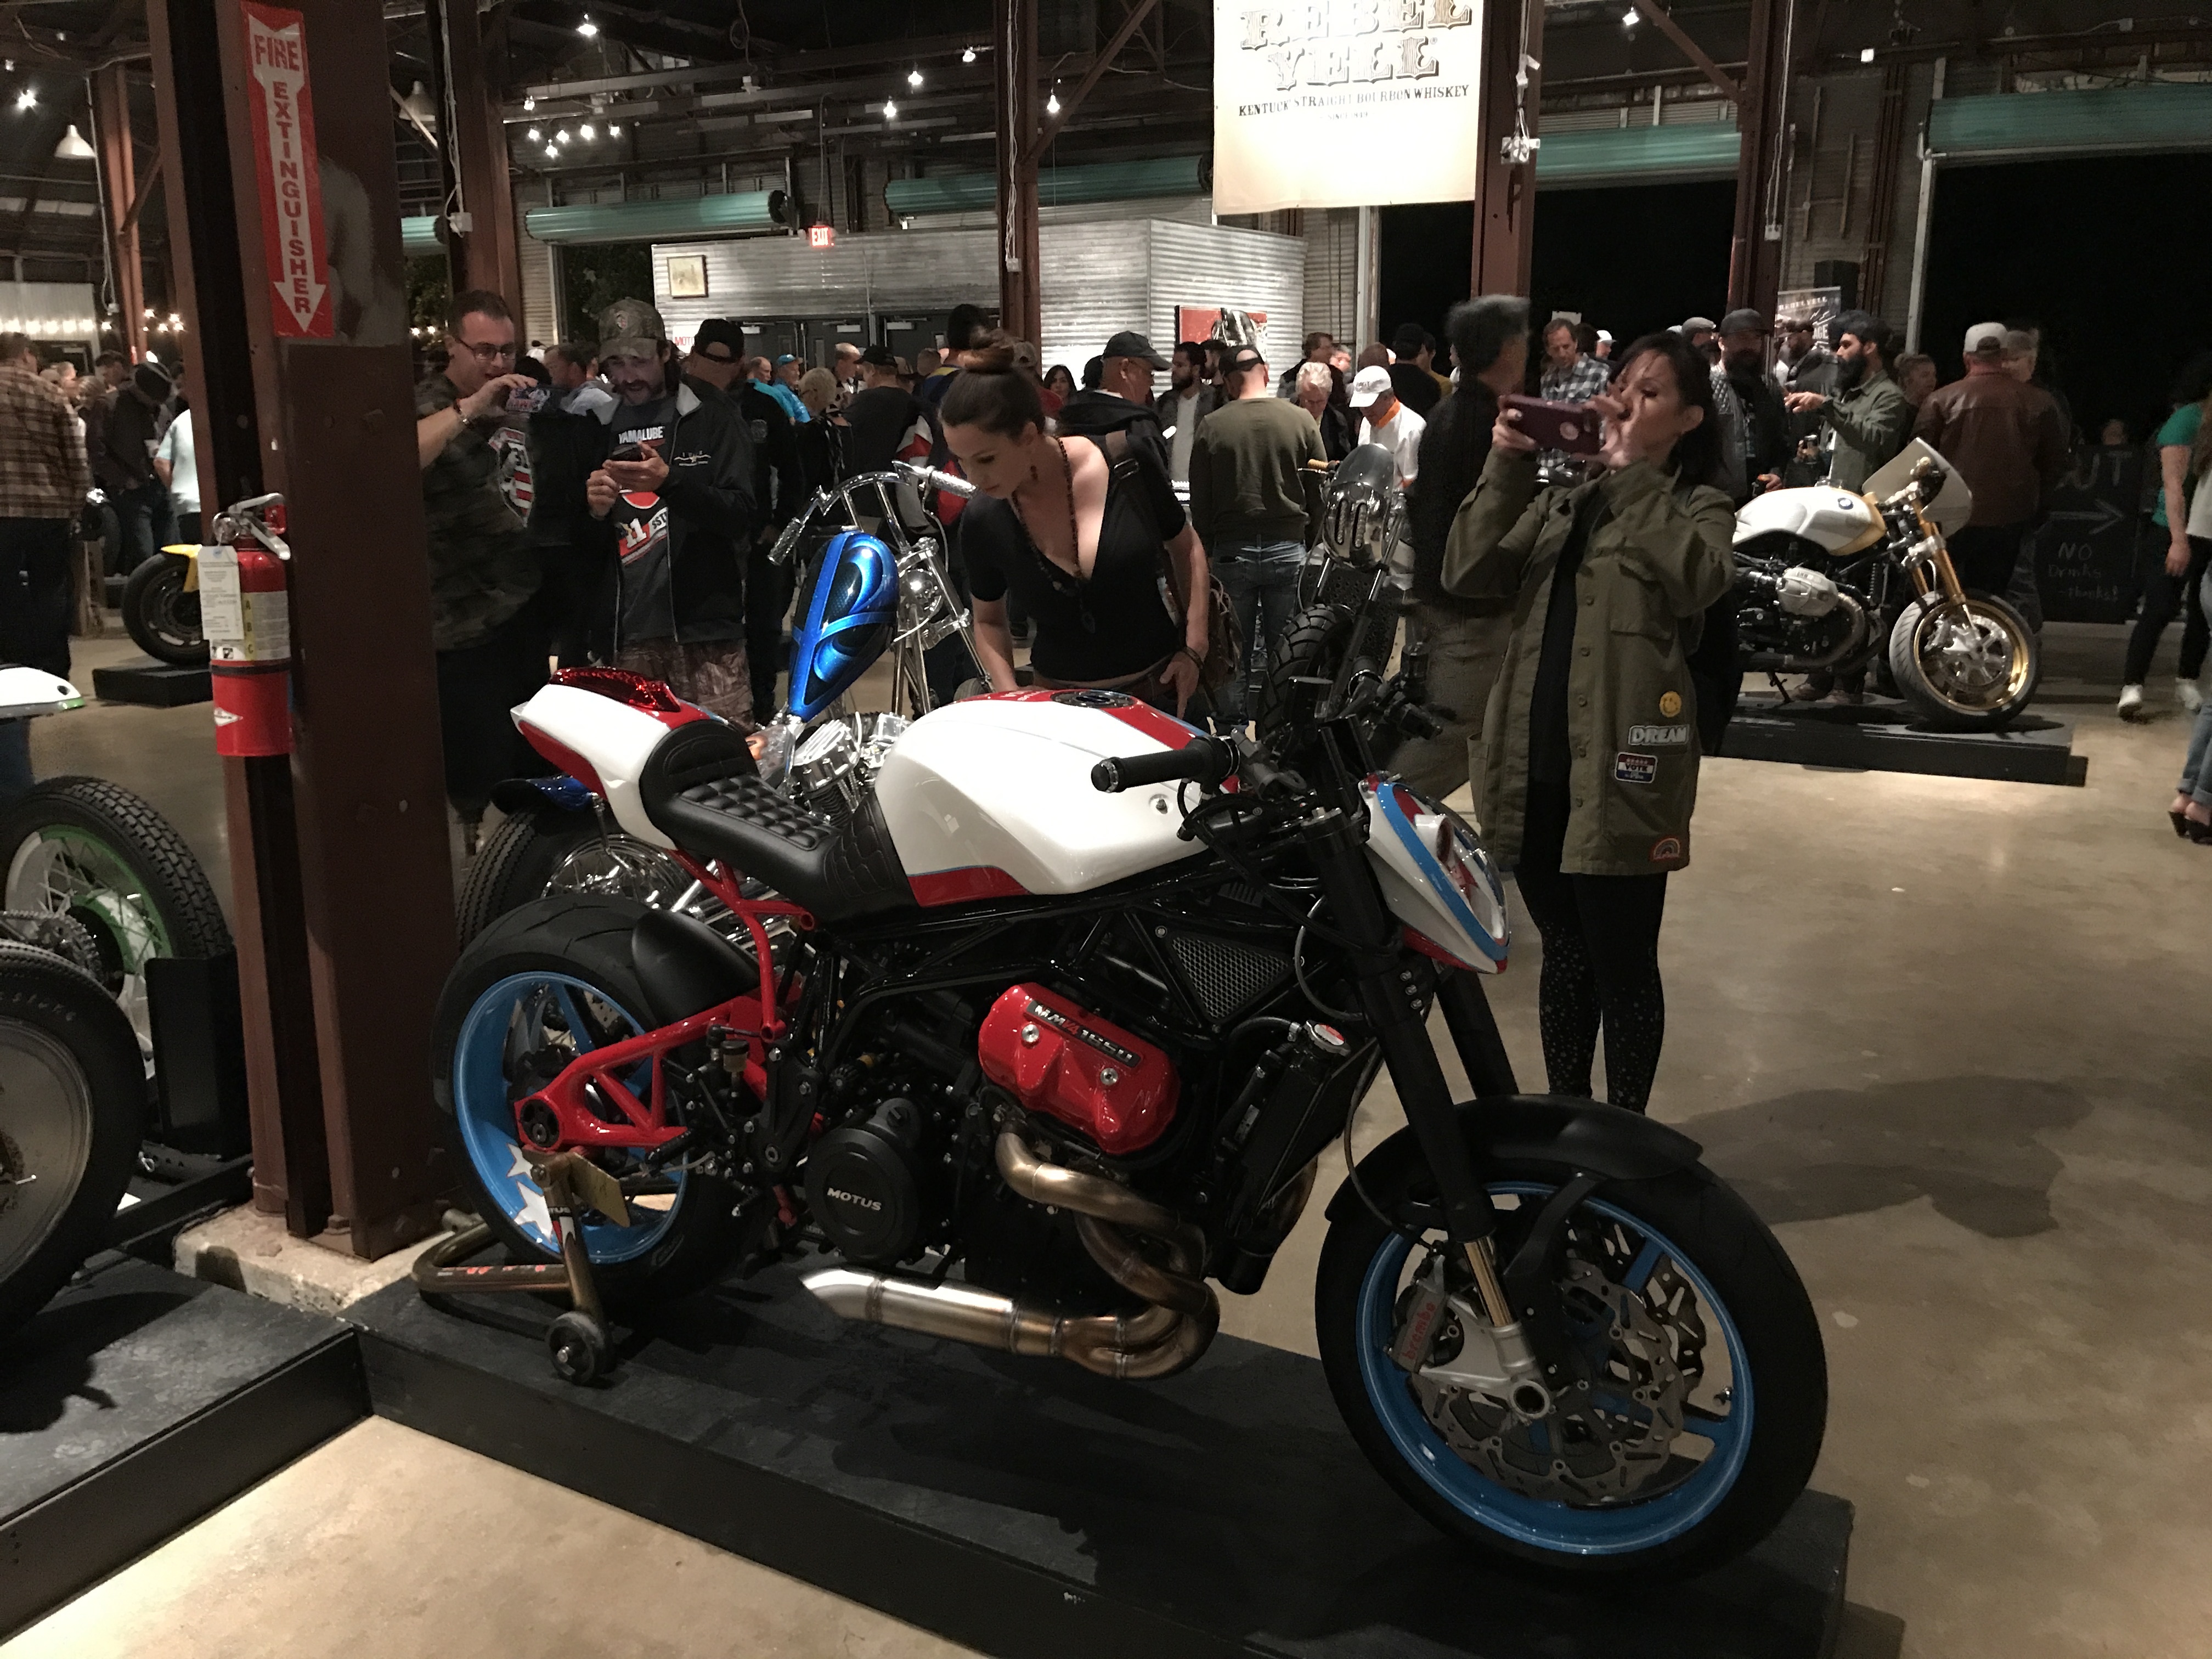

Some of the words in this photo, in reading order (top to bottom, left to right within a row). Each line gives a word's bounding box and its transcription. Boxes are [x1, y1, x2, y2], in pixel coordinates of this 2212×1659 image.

[254, 35, 300, 71] FIRE
[1413, 84, 1469, 99] WHISKEY
[273, 81, 311, 314] EXTINGUISHER
[811, 227, 829, 246] EXIT
[618, 426, 664, 444] YAMALUBE
[2058, 541, 2092, 561] NO
[1631, 727, 1688, 743] DREAM
[827, 1187, 882, 1211] MOTUS
[1401, 1301, 1436, 1360] brembo
